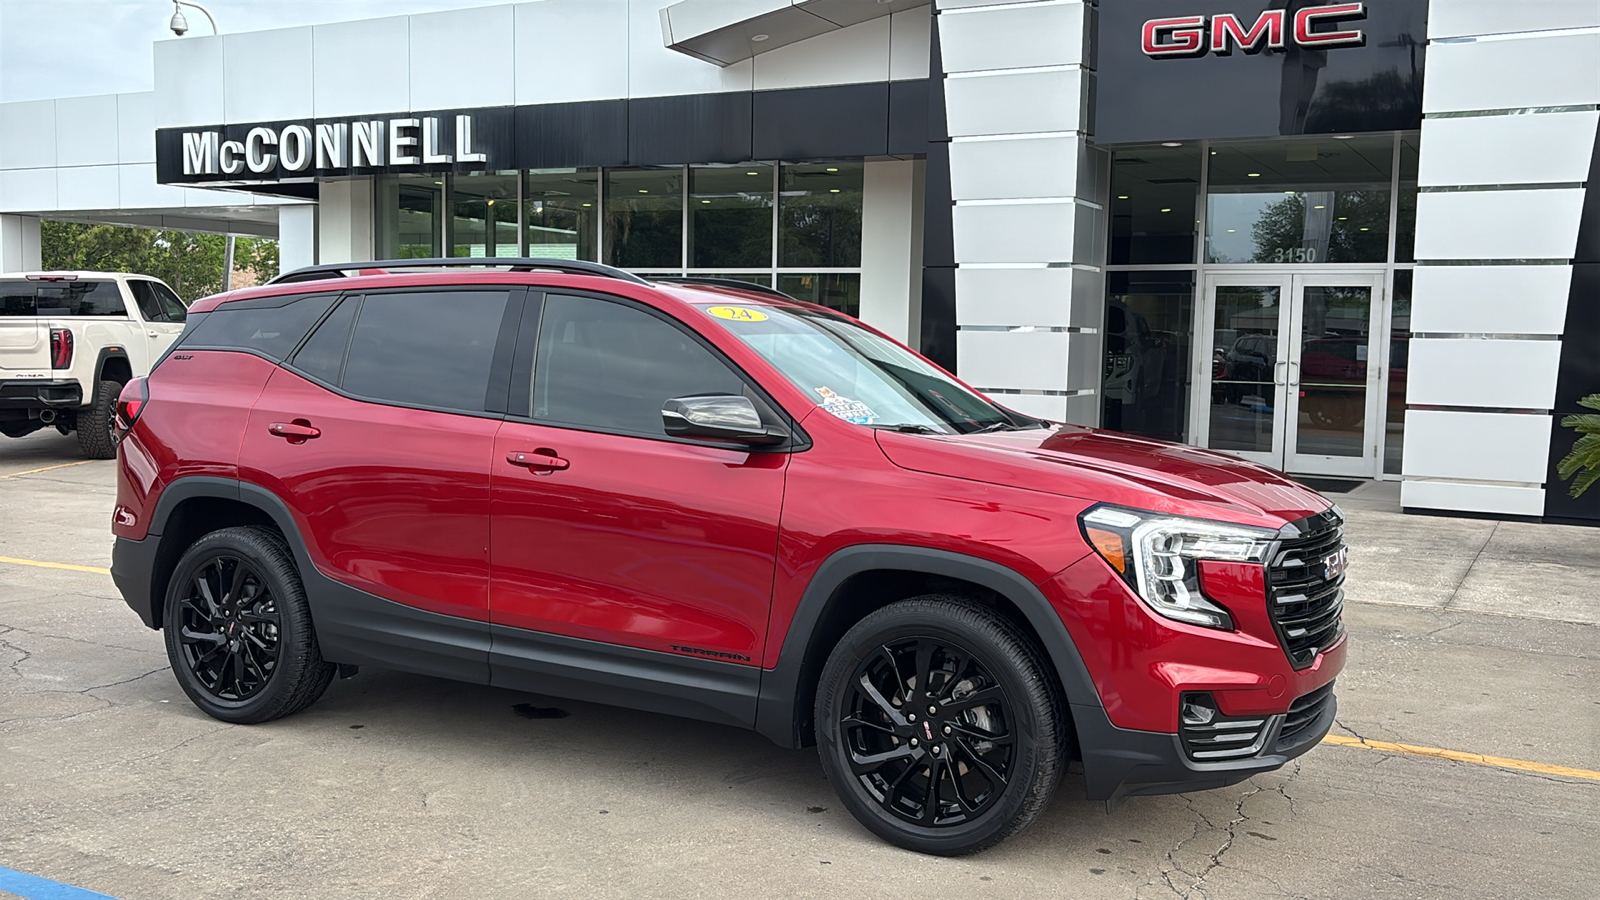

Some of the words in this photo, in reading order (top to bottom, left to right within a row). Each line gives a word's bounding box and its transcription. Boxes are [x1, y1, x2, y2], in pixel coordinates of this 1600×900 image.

[1142, 2, 1367, 57] GMC
[182, 114, 487, 175] McCONNELL
[1274, 247, 1316, 263] 3150
[724, 307, 752, 319] 24
[669, 644, 751, 661] TERRAIN
